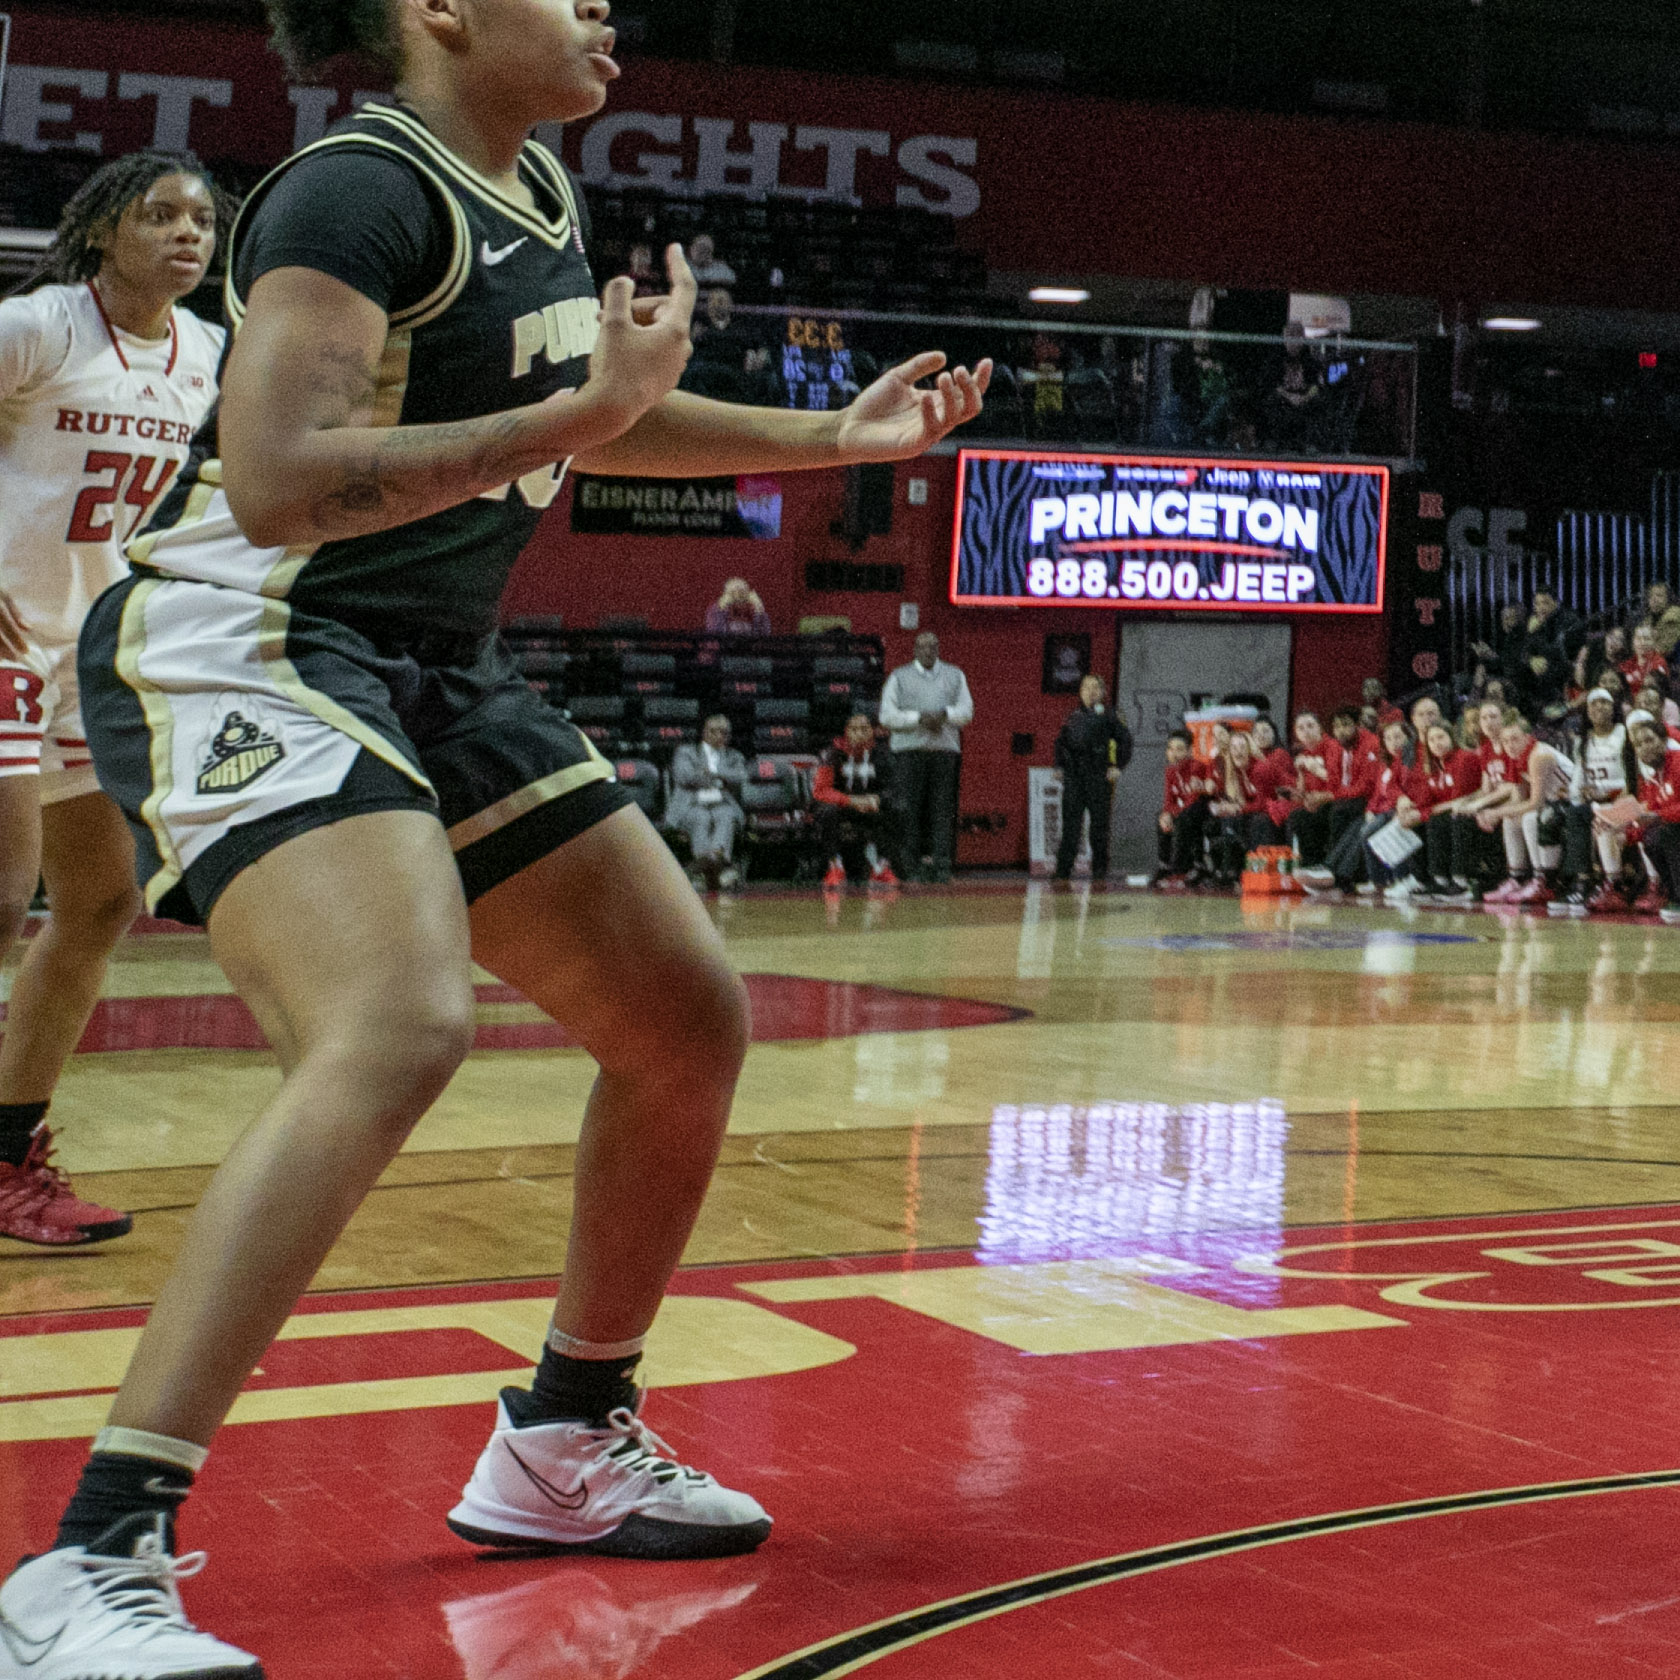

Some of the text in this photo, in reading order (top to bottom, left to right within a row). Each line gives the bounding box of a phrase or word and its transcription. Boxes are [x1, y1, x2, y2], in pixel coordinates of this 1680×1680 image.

[65, 449, 180, 545] 24
[1206, 467, 1251, 489] Jeep
[1029, 490, 1319, 553] PRINCETON
[1027, 558, 1316, 603] 888.500.JEEP
